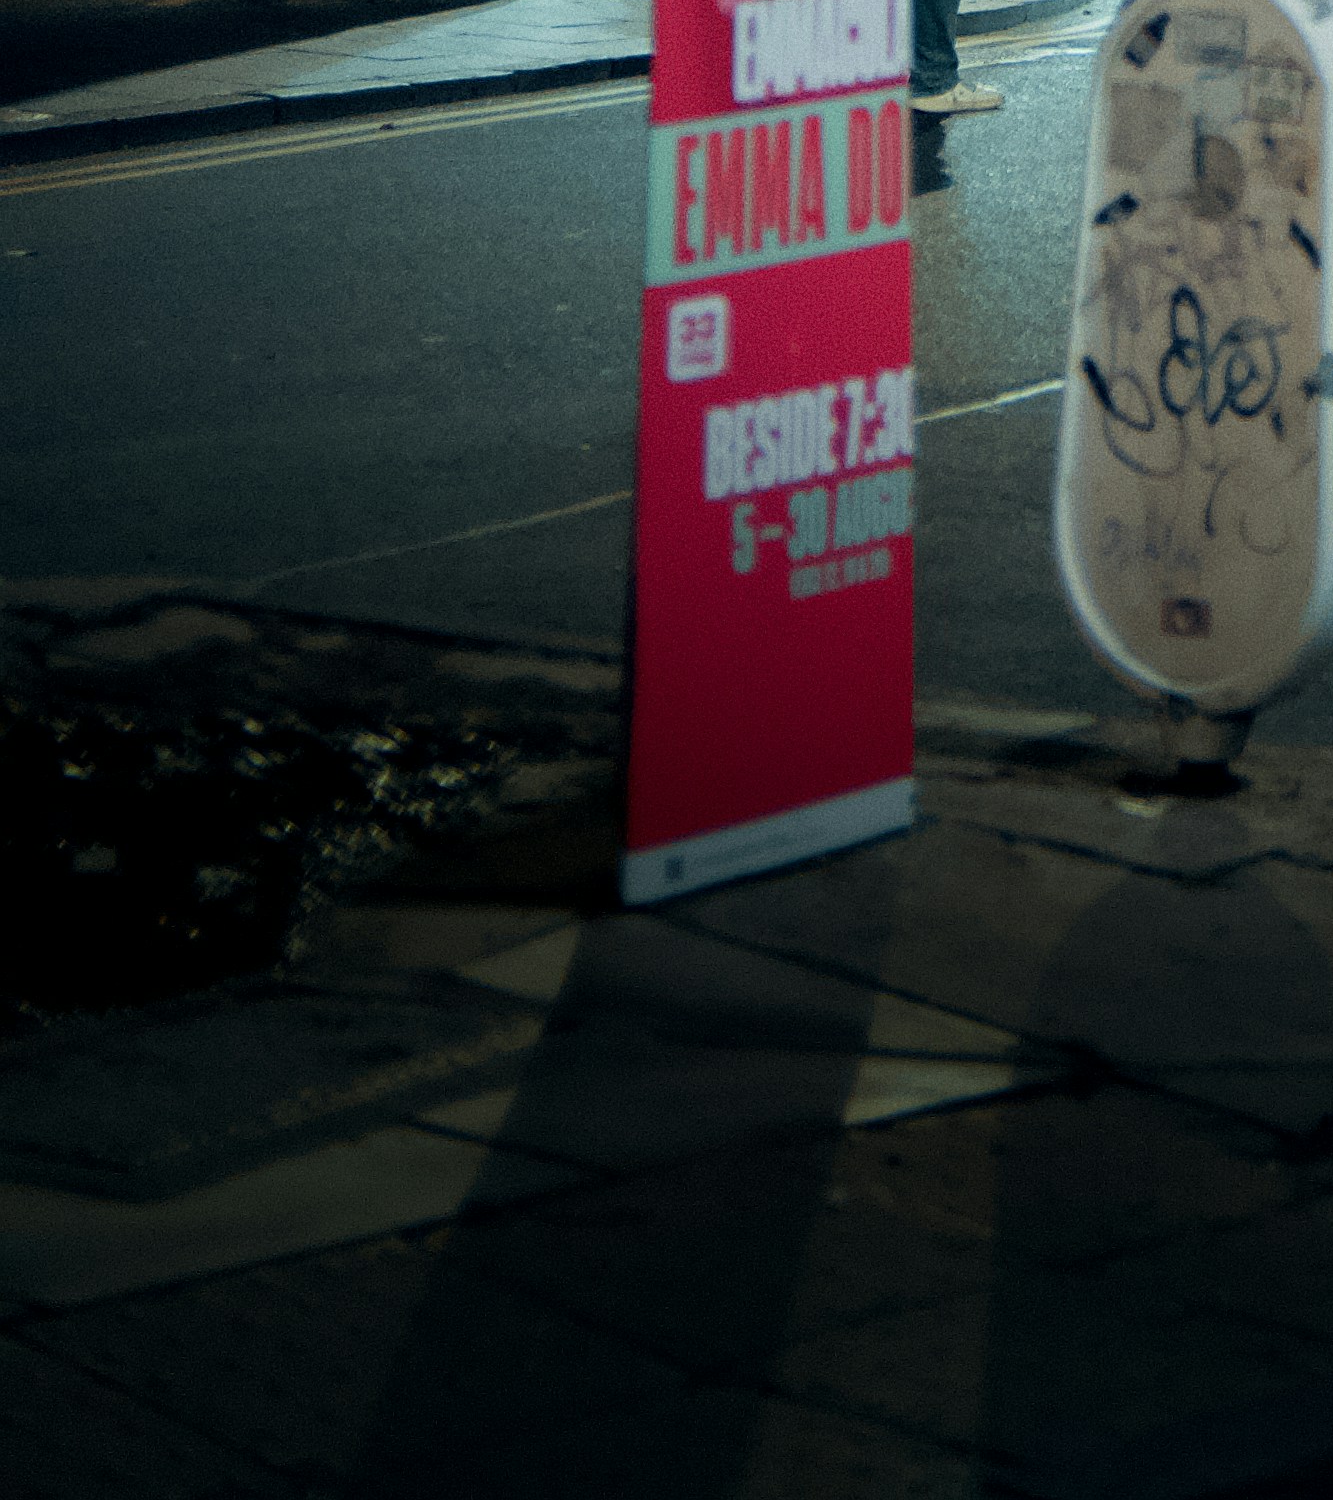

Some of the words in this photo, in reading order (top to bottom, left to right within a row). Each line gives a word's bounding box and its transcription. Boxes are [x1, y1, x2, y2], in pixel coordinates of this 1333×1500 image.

[673, 112, 826, 267] EMMA
[706, 384, 837, 502] BESIDE
[732, 501, 755, 575] 5
